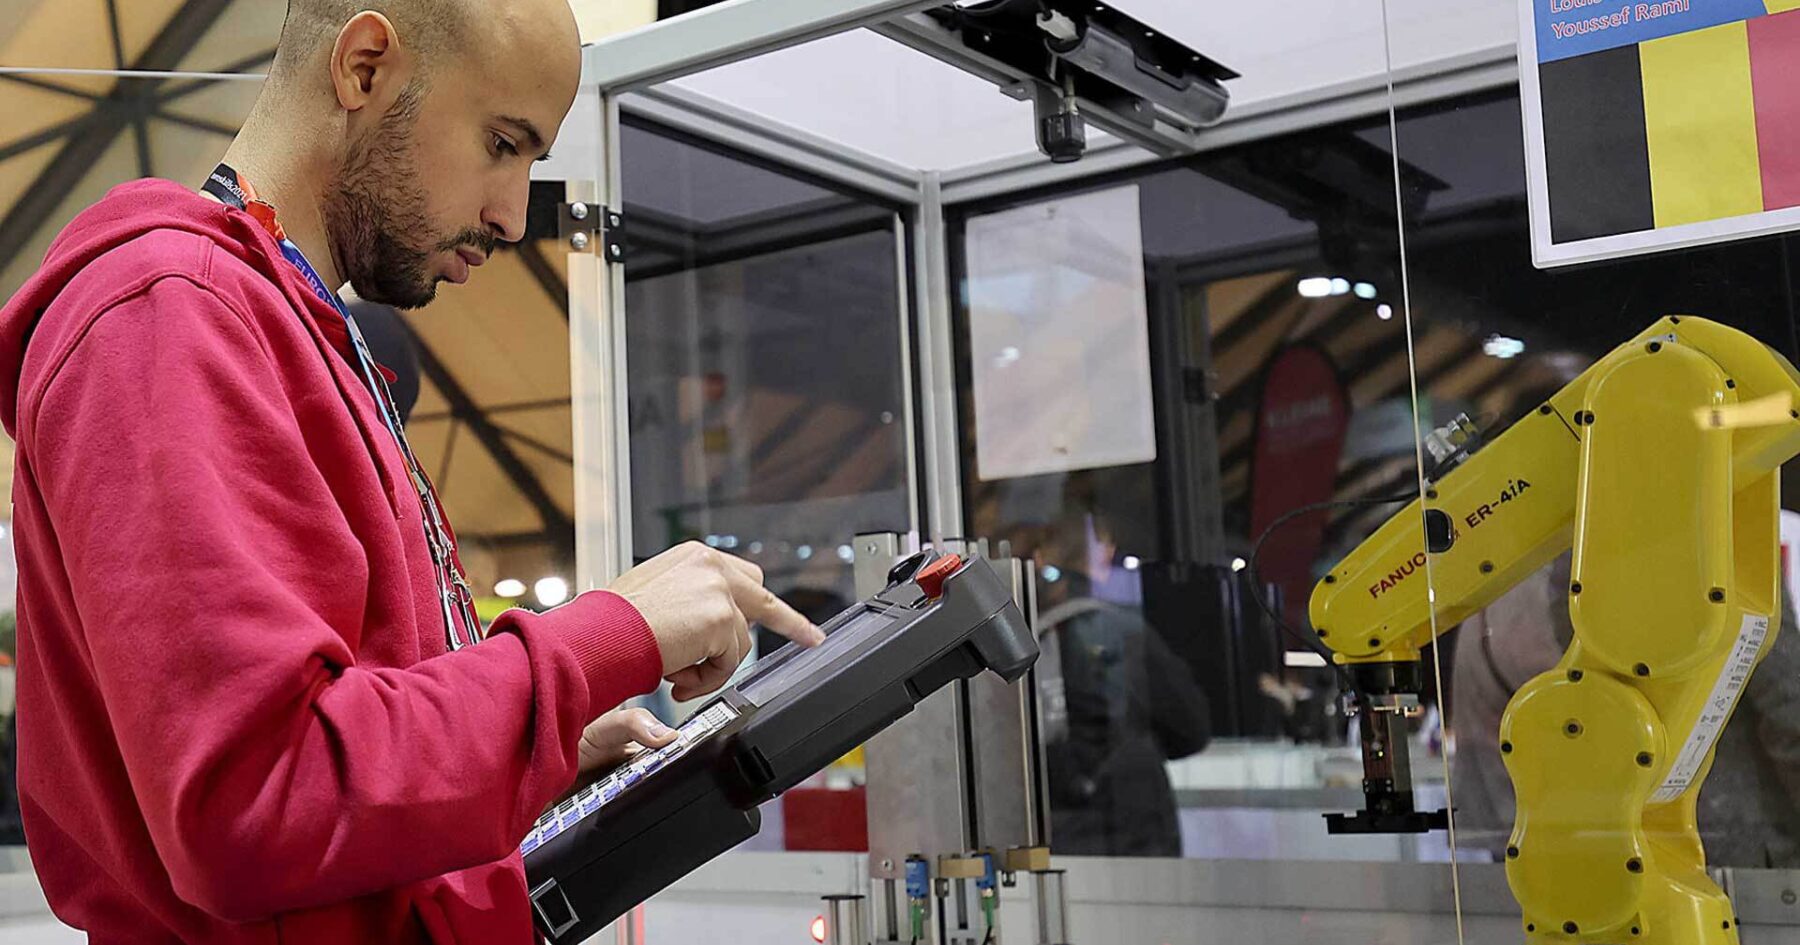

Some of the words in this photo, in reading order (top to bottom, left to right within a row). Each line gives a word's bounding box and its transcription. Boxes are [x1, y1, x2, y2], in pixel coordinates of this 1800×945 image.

[1551, 0, 1601, 13] Lou
[1551, 6, 1630, 39] Youssef
[1369, 552, 1427, 598] FANUC
